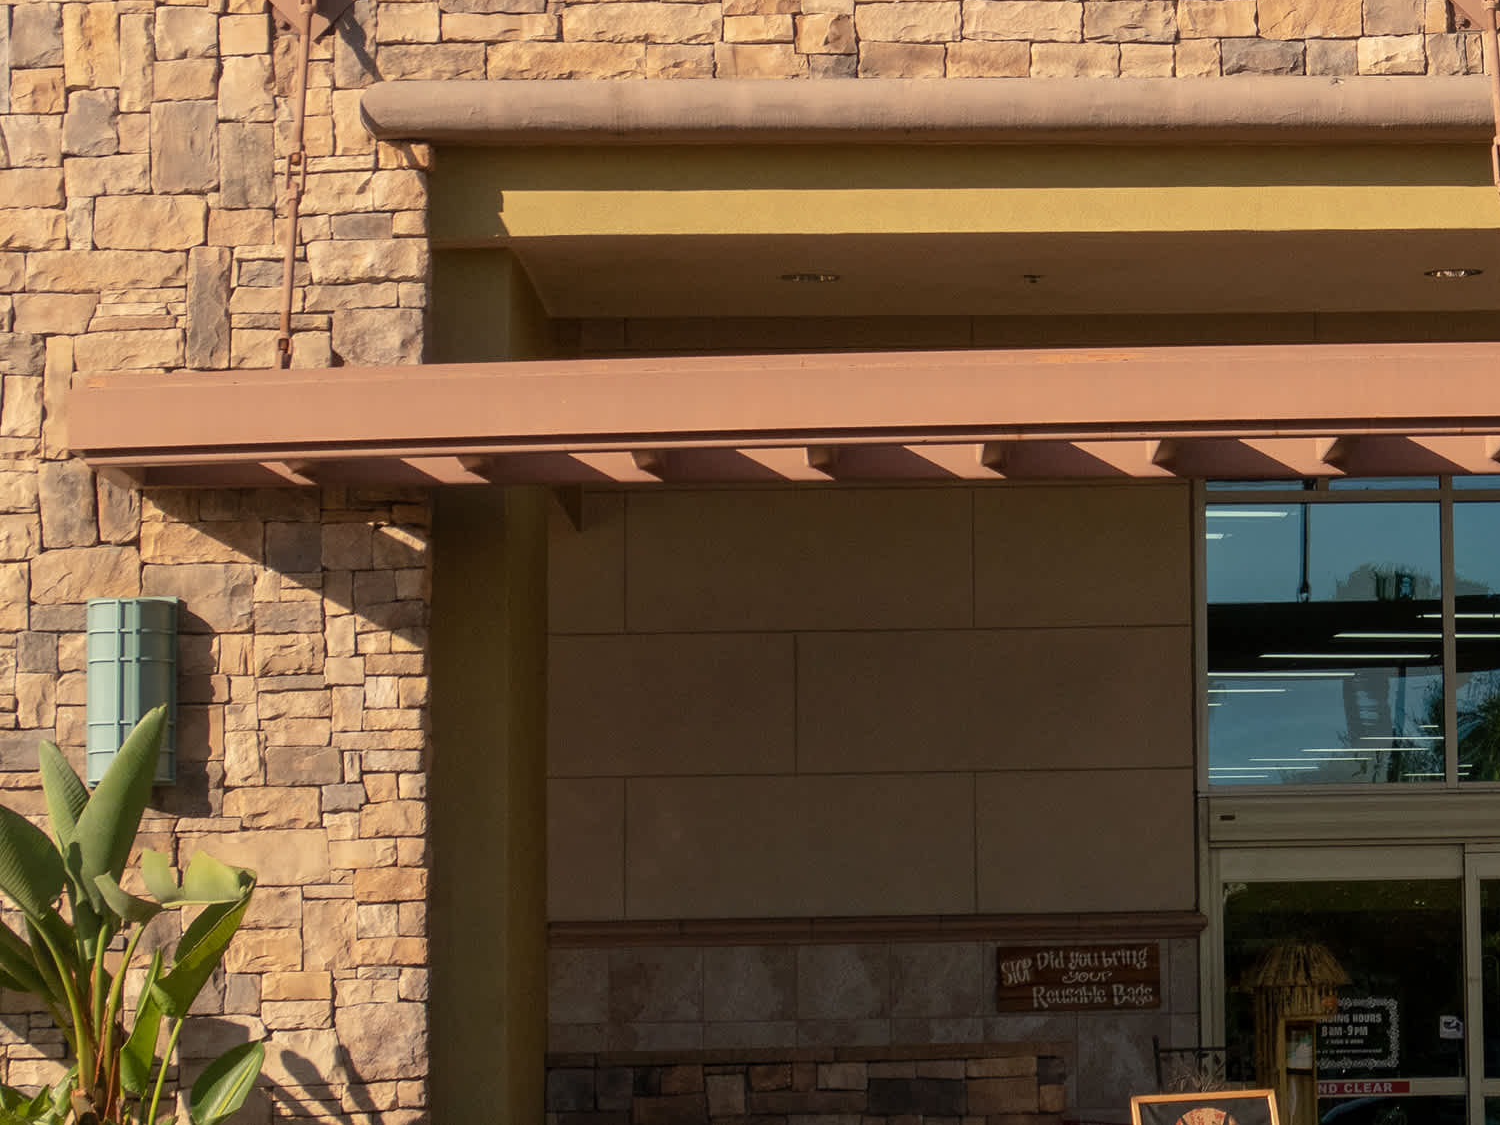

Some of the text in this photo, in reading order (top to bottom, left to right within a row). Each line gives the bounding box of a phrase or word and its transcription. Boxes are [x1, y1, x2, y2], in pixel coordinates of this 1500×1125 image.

[1036, 947, 1148, 971] Did you bring
[1001, 957, 1033, 986] STOP
[1061, 970, 1113, 984] your
[1032, 983, 1153, 1009] Reusable Bags
[1352, 1013, 1382, 1023] HOURS
[1343, 1082, 1393, 1093] CLEAR
